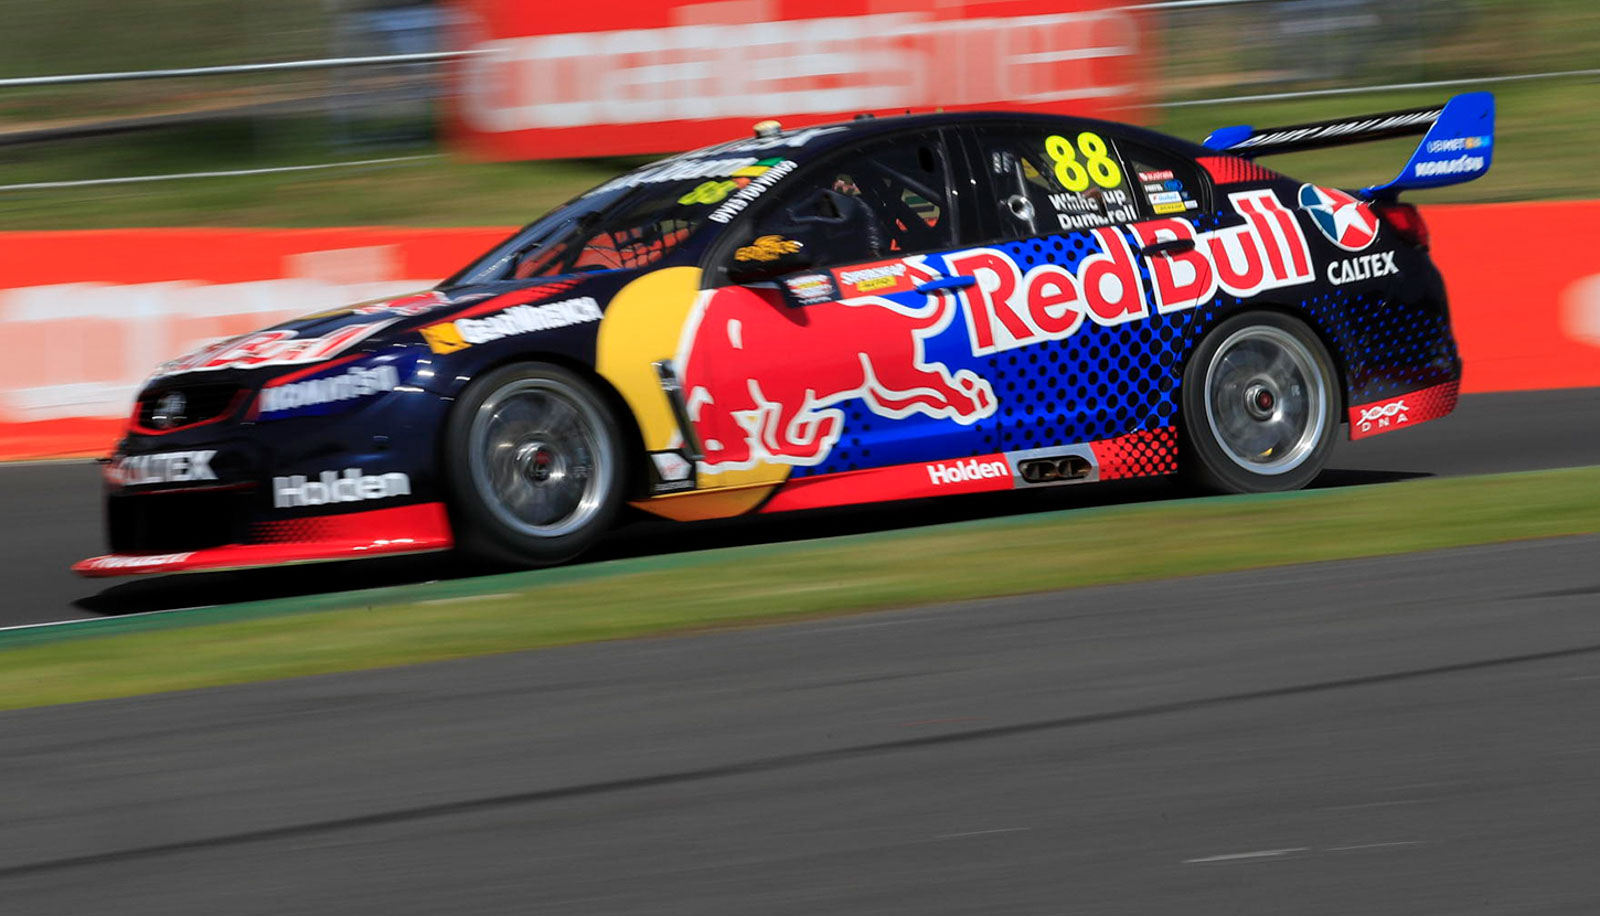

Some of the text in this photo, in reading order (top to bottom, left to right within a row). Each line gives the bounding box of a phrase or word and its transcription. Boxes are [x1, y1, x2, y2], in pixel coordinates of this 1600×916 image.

[1045, 131, 1122, 192] 88
[951, 188, 1316, 357] Red Bull
[1327, 251, 1399, 286] CALTEX
[272, 467, 412, 508] Holden
[926, 459, 1009, 485] Holden
